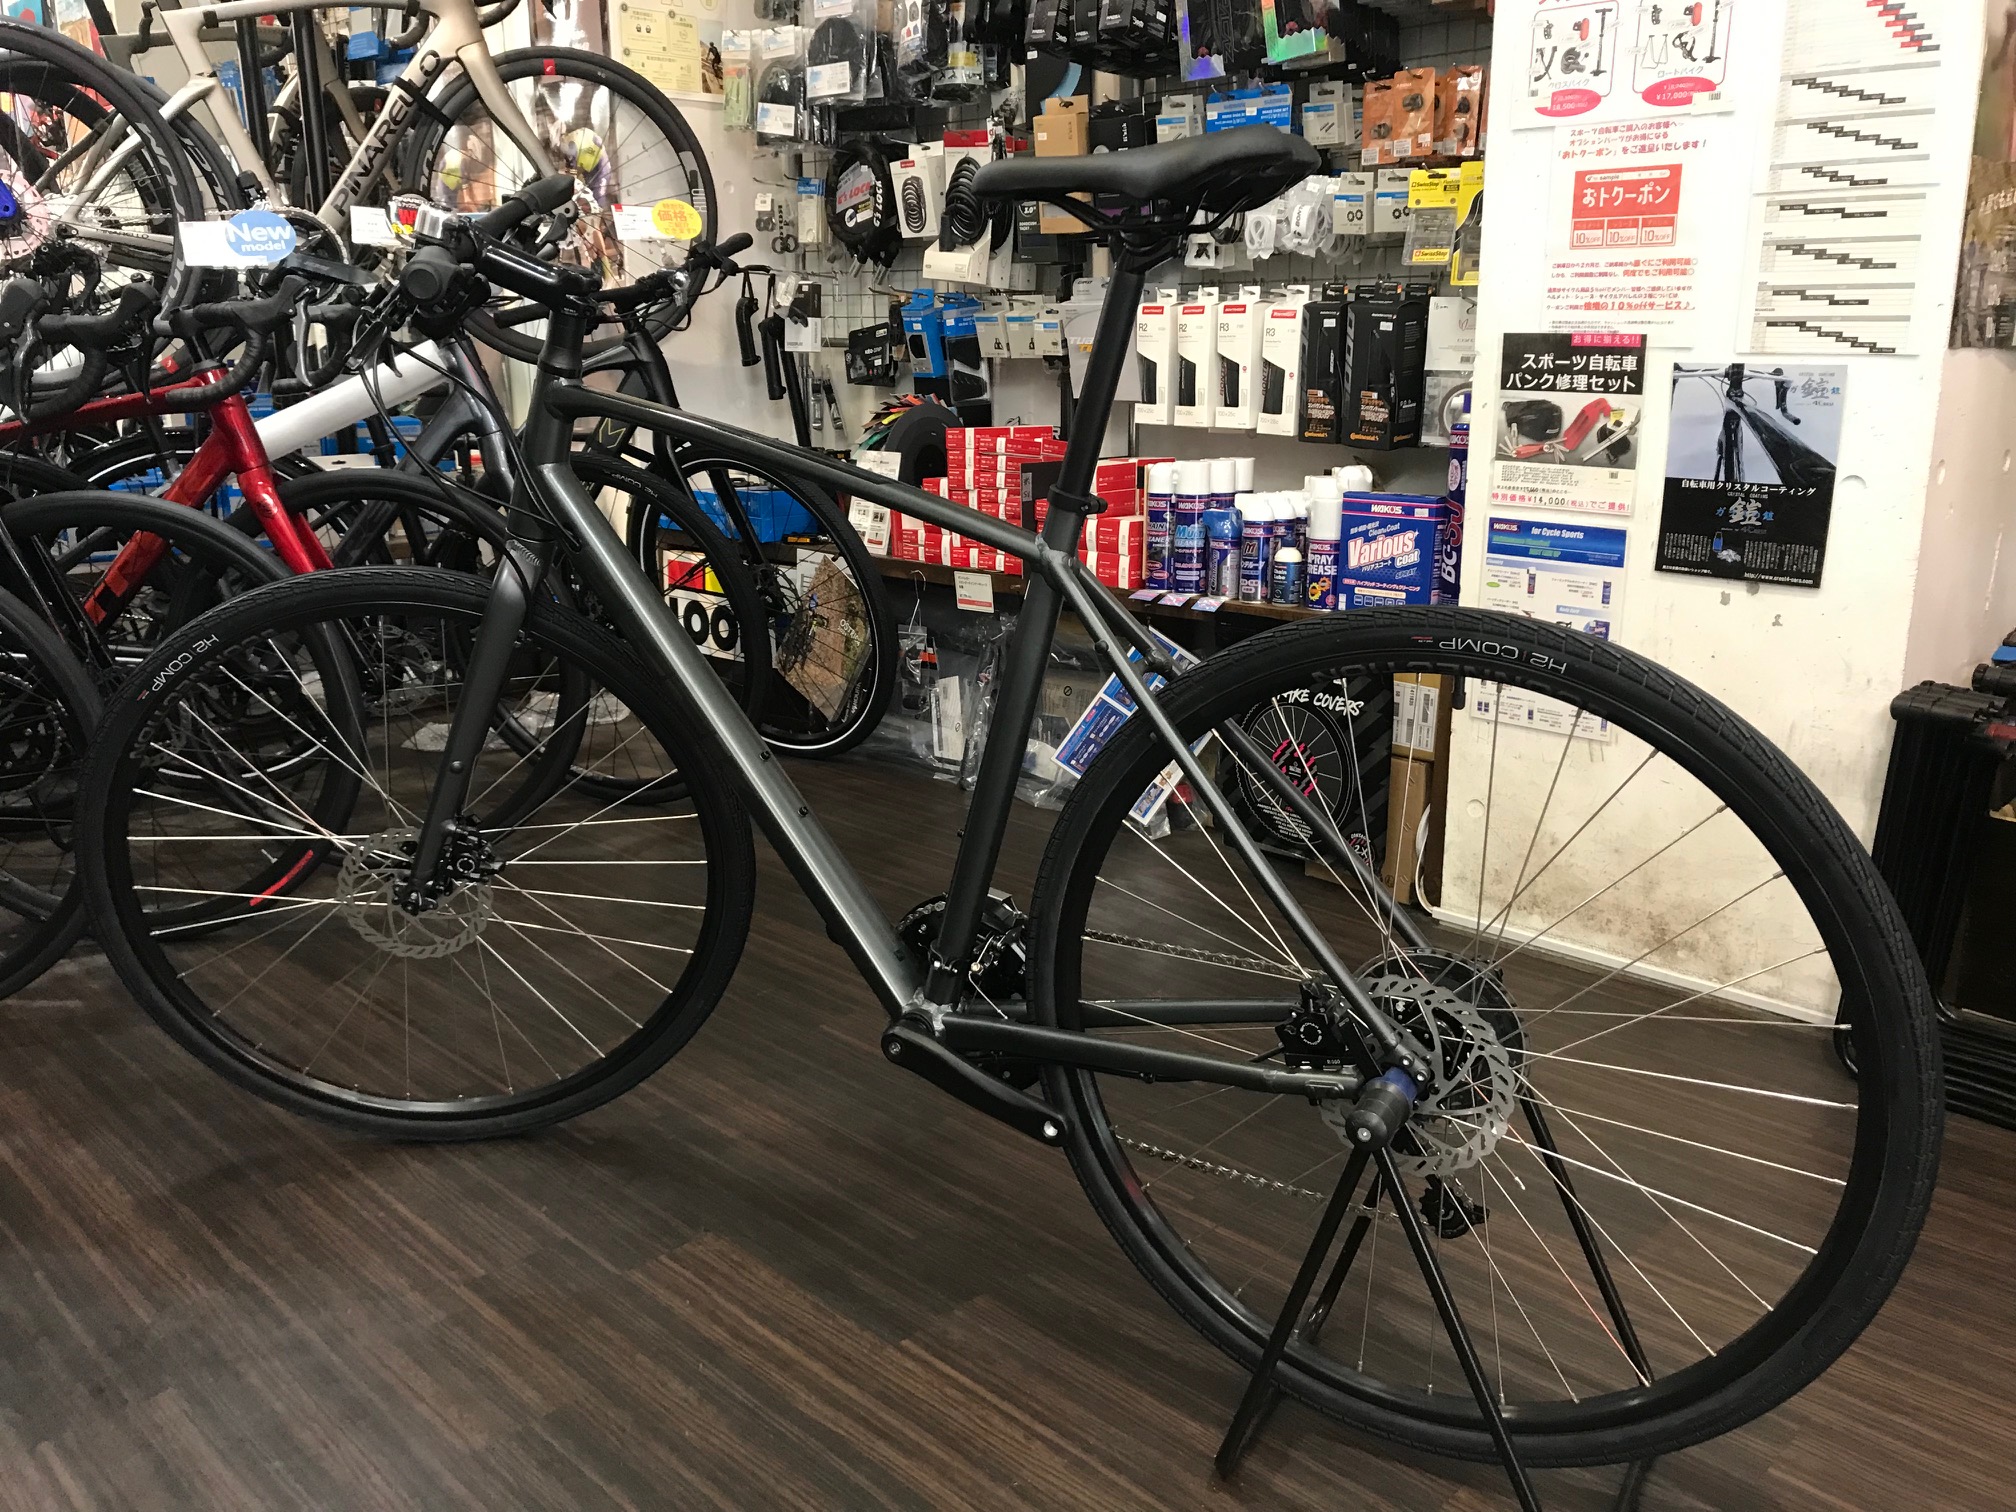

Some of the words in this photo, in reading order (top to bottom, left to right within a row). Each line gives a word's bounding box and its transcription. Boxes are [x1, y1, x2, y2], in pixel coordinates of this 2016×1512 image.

[875, 180, 883, 211] LOCK
[1582, 181, 1671, 208] おトクーポン
[227, 222, 290, 243] New
[241, 240, 286, 252] model
[1138, 323, 1148, 332] R2
[1178, 323, 1188, 333] R2
[1219, 322, 1230, 332] R3
[1265, 327, 1276, 337] R3
[1521, 352, 1638, 372] スポーツ自転車
[1506, 371, 1636, 393] パンク修理セット
[1681, 479, 1817, 497] 自転車用クリスタルコーティング
[1531, 526, 1541, 535] for
[1542, 527, 1561, 537] Cycle
[1561, 529, 1585, 539] Sports
[1348, 530, 1416, 570] Various
[1395, 548, 1420, 569] coat
[1395, 567, 1418, 580] SPRAY
[192, 634, 220, 653] H2
[1438, 637, 1519, 660] COMP
[151, 652, 193, 692] COMP
[1529, 651, 1567, 675] H2
[1313, 692, 1365, 717] COVERS
